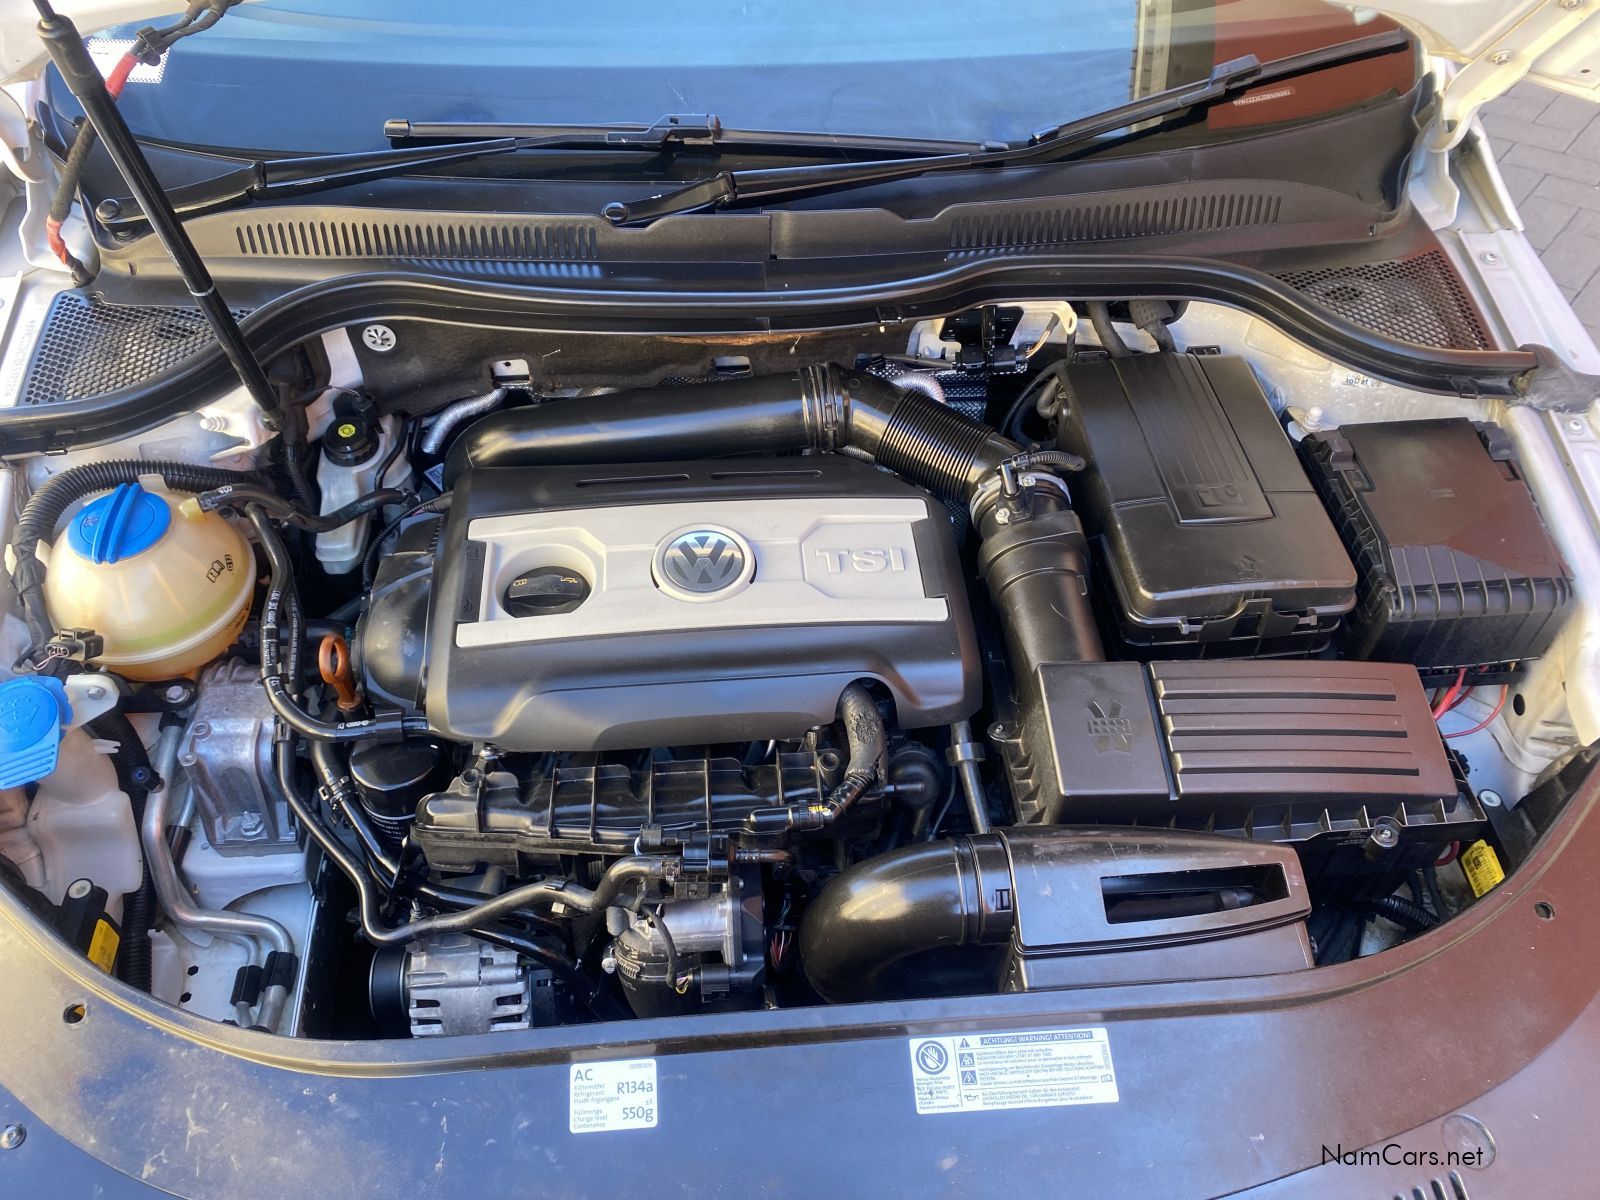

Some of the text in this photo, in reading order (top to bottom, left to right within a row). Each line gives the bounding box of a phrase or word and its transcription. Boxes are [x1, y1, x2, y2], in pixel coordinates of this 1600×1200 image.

[815, 547, 905, 574] TSI
[574, 1068, 593, 1082] AC
[617, 1080, 653, 1094] R134a
[622, 1106, 654, 1122] 550g
